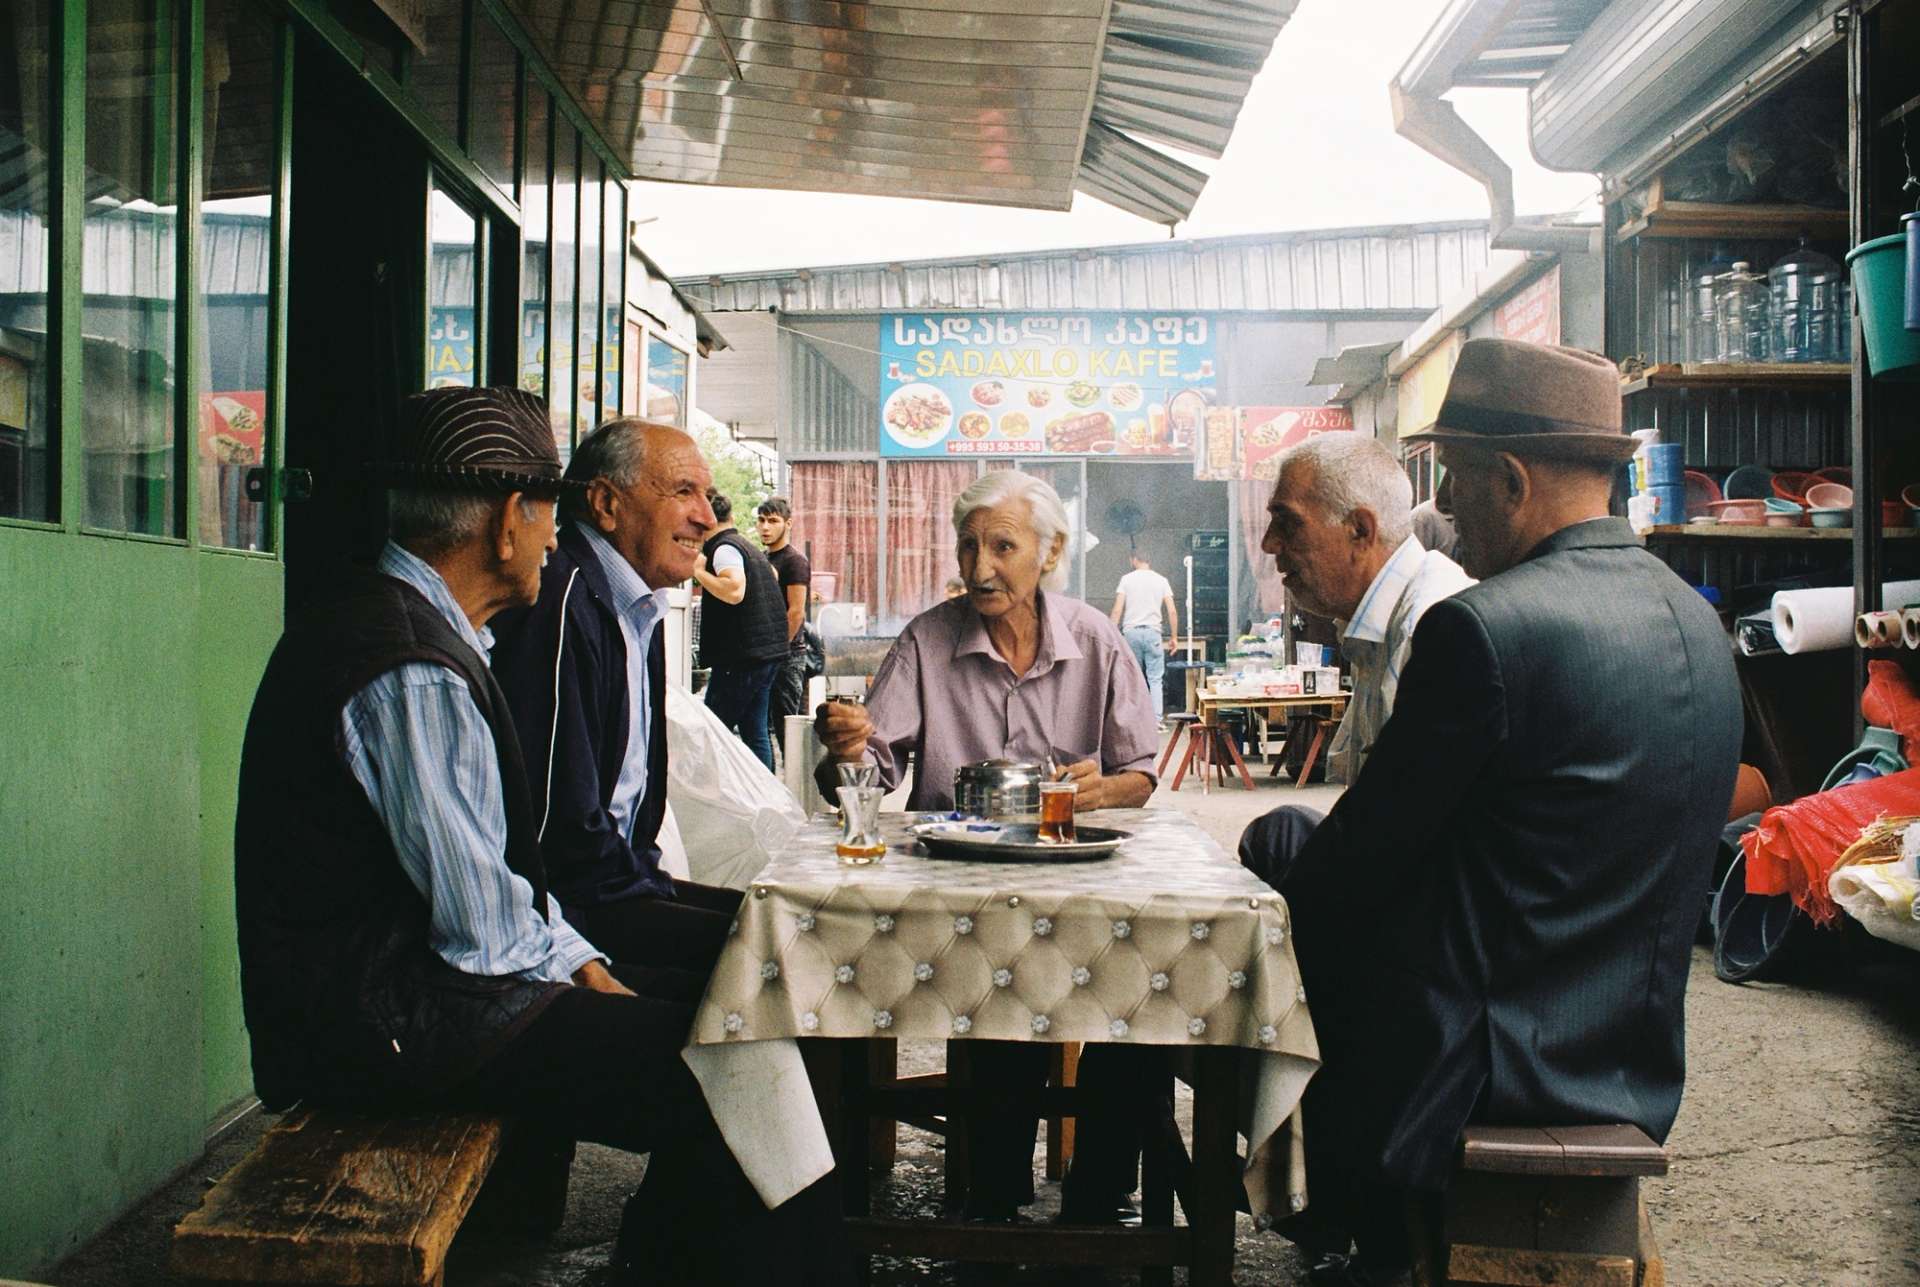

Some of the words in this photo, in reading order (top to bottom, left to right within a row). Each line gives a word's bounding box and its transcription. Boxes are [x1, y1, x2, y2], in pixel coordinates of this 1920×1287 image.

[894, 317, 1092, 346] სადახლო
[1104, 317, 1208, 345] კაფე
[915, 349, 1078, 377] SADAXLO
[1089, 349, 1179, 377] KAFE
